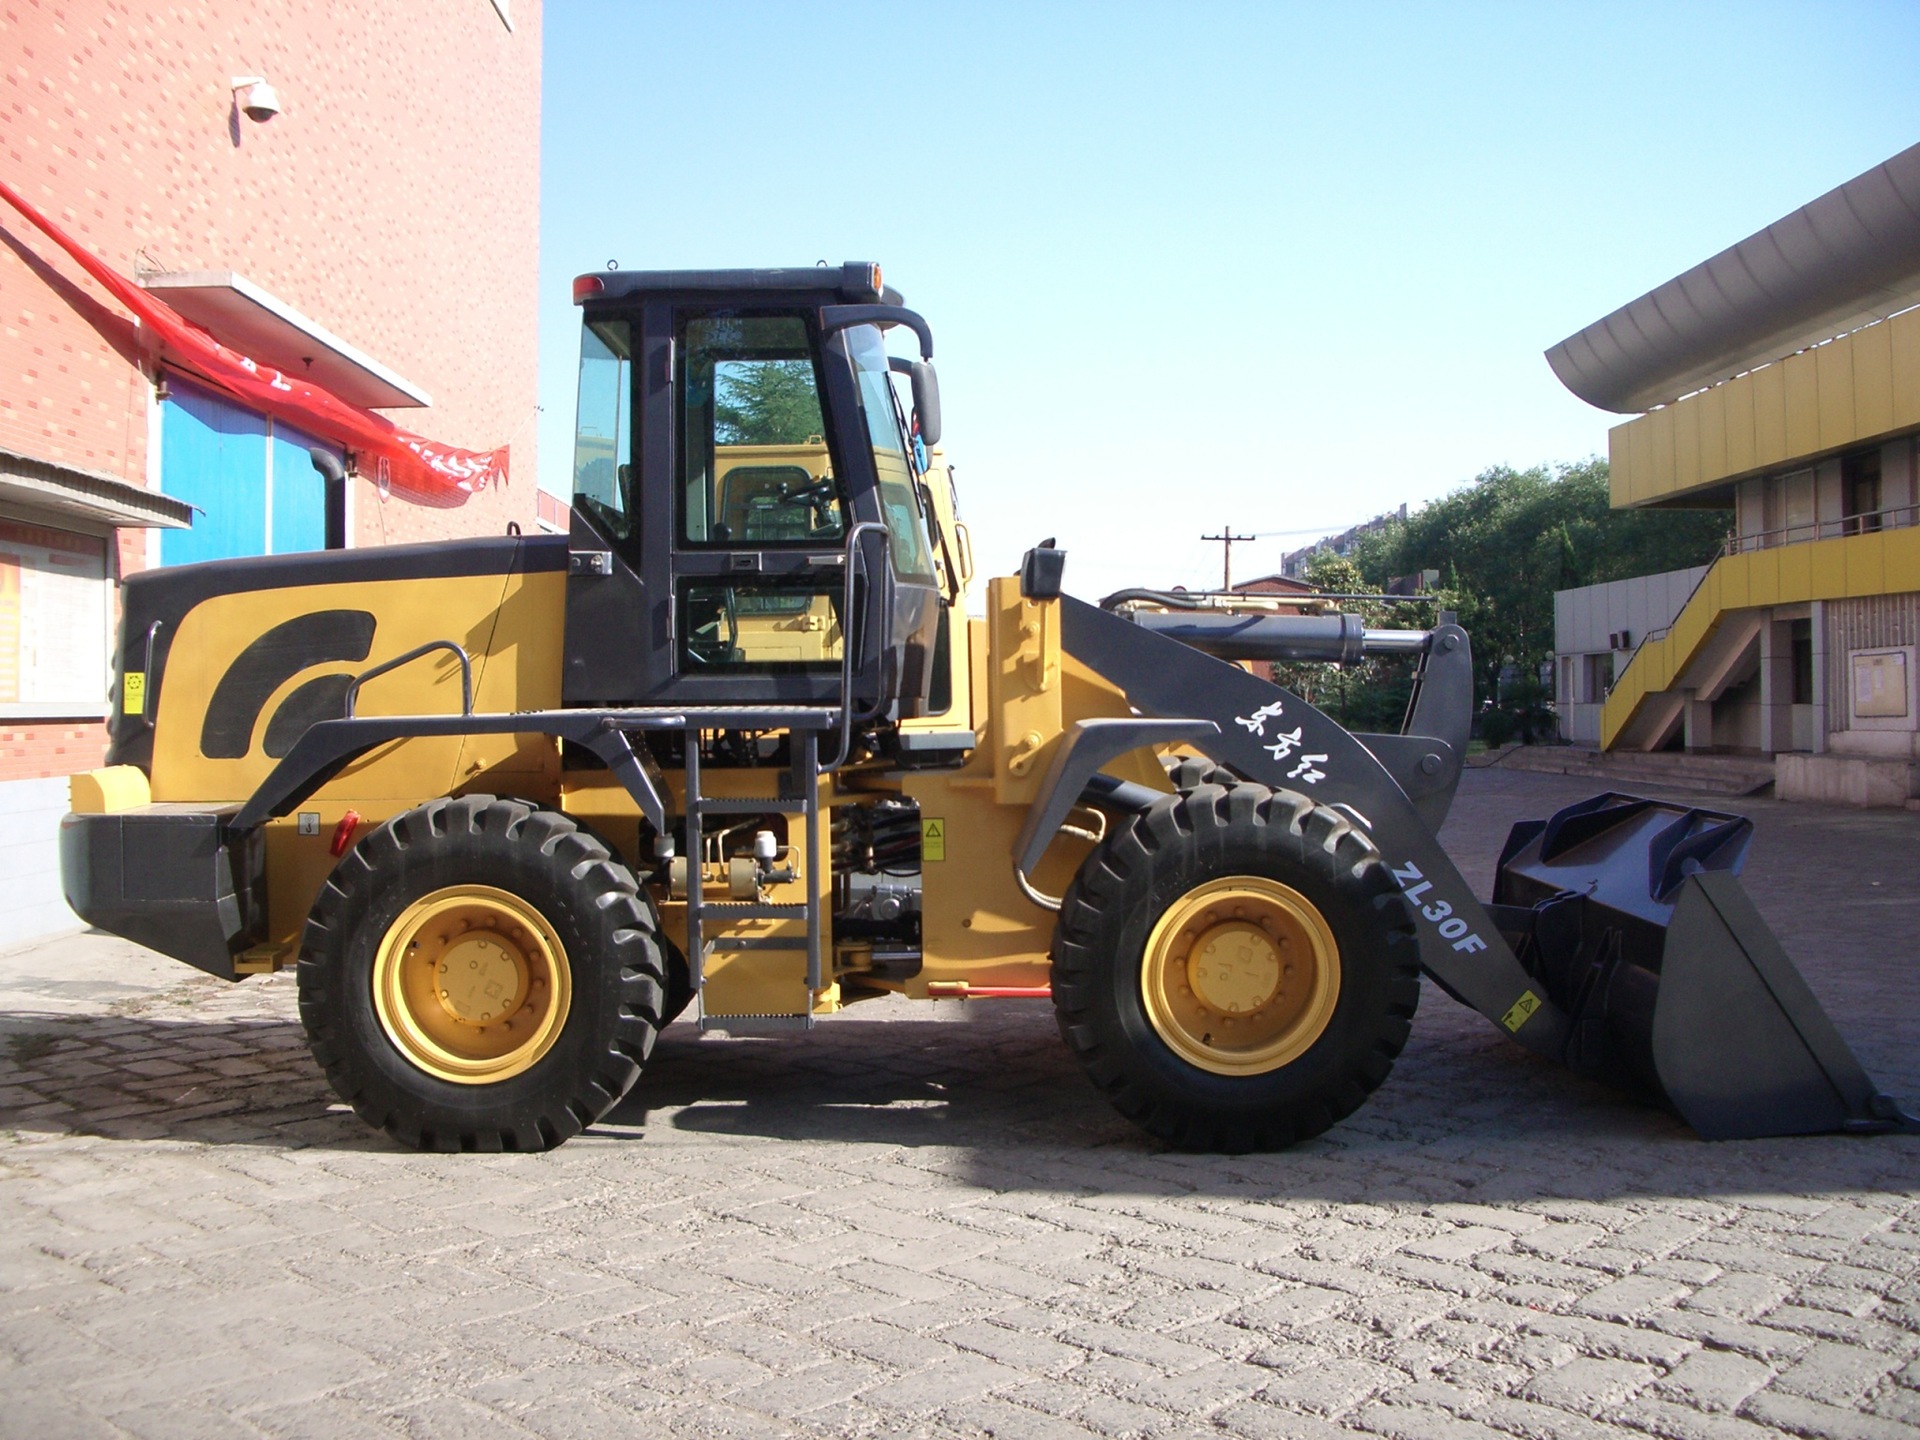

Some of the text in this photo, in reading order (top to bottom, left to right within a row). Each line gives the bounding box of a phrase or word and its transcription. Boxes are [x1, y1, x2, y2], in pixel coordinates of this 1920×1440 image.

[1234, 701, 1329, 784] 东方红
[1391, 860, 1488, 954] ZL30F
